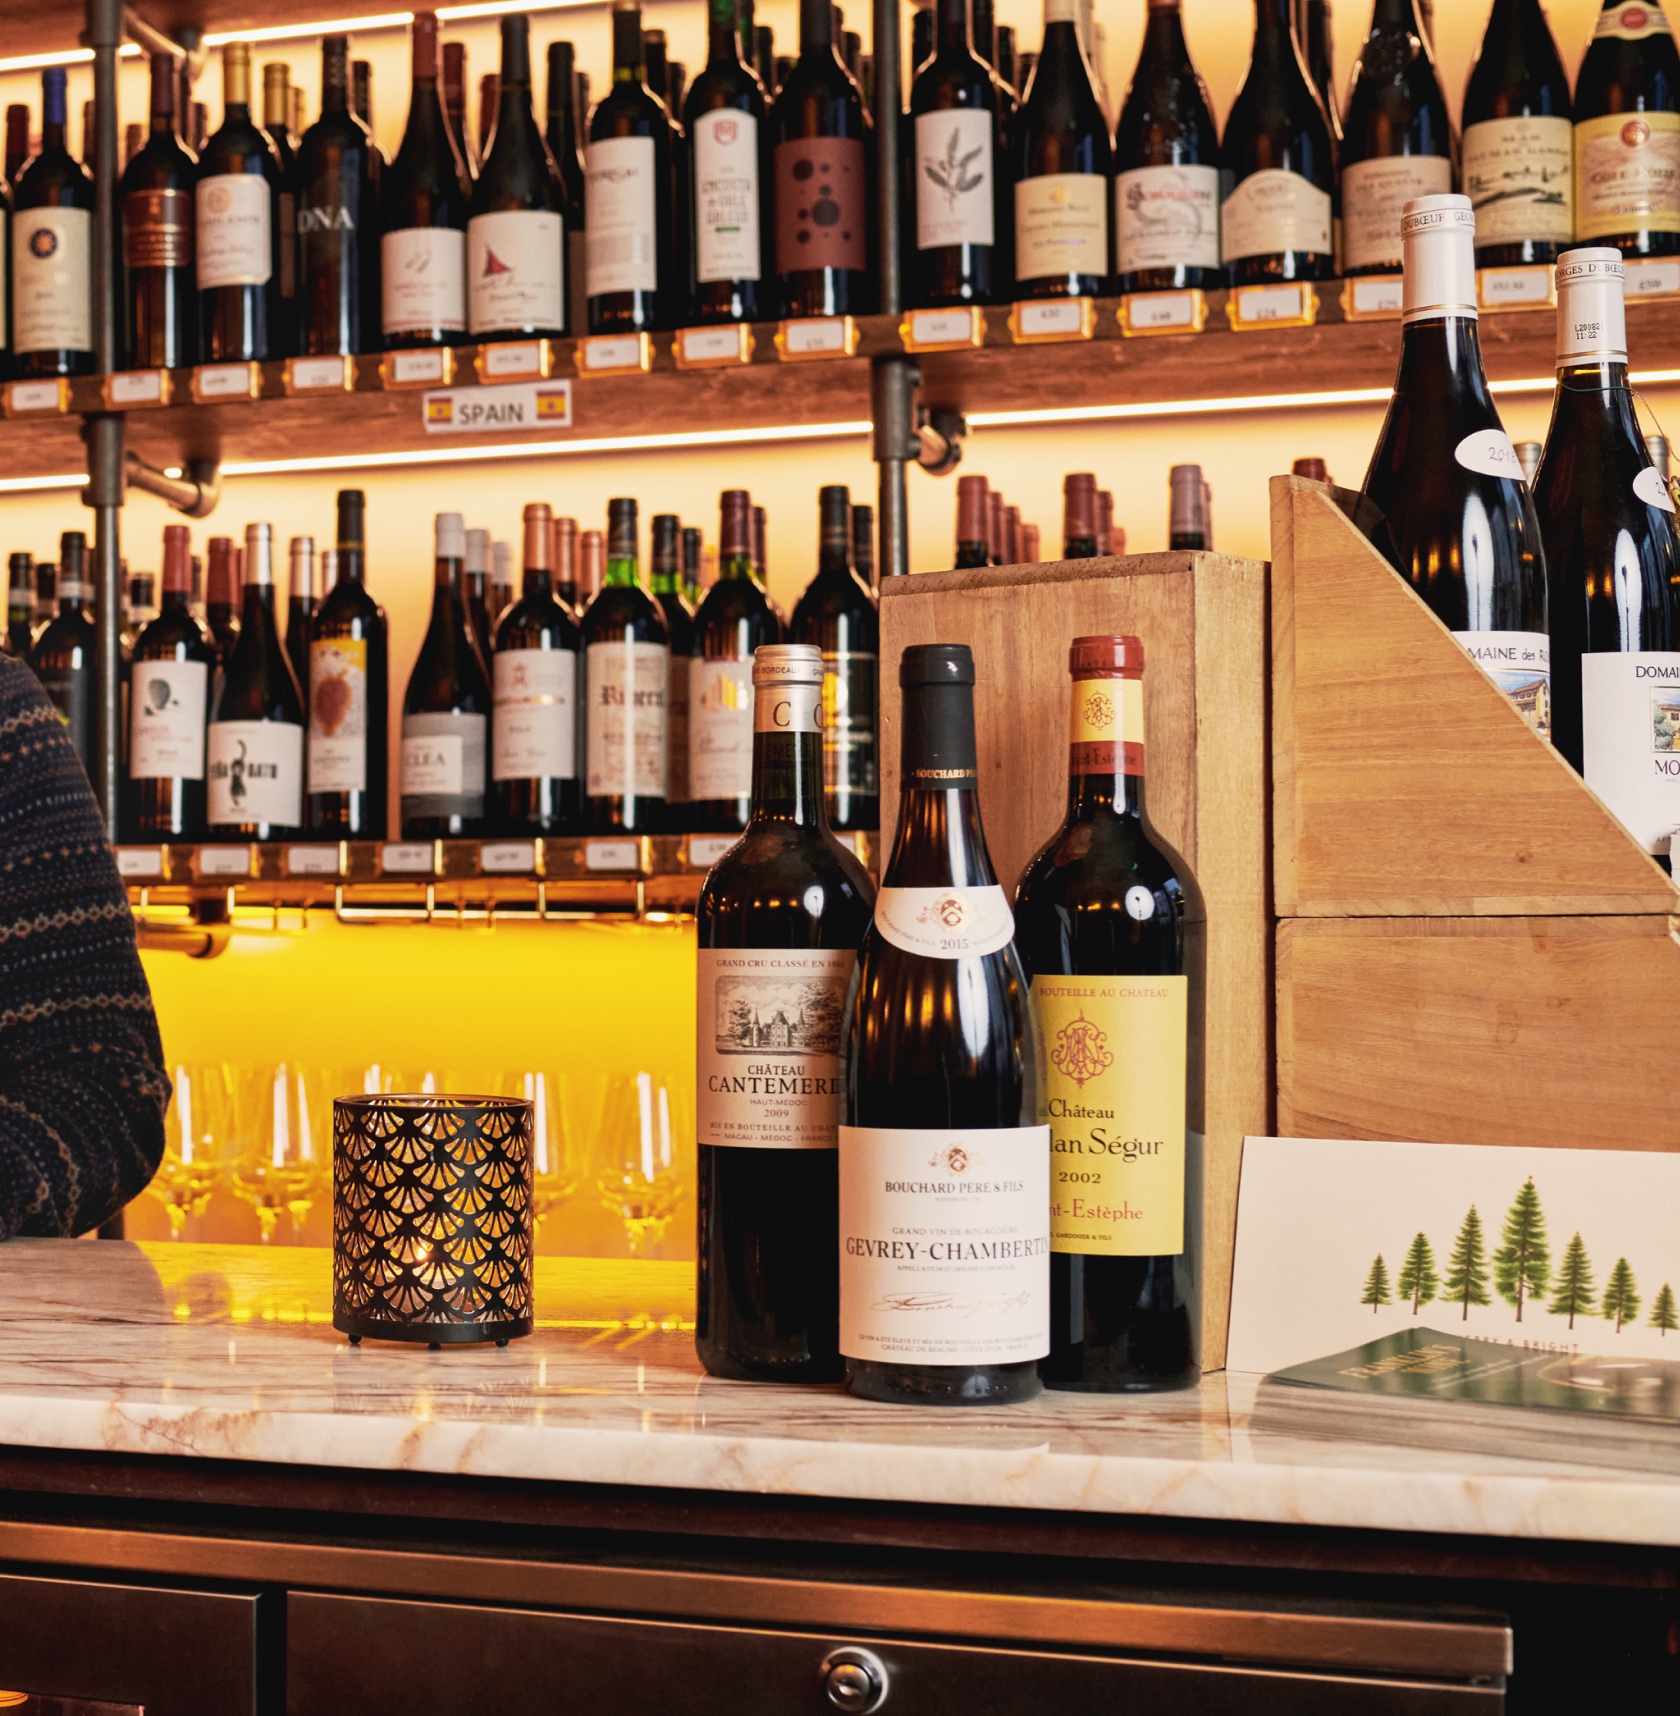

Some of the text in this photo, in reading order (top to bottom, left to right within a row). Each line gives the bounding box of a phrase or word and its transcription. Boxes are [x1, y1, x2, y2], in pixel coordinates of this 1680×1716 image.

[1403, 212, 1444, 230] DUBŒUF
[1555, 264, 1583, 280] ORGES
[1576, 331, 1598, 340] 11:22
[458, 403, 524, 425] SPAIN
[1469, 647, 1517, 661] MAINE
[1521, 649, 1535, 661] des
[762, 666, 801, 675] BORDEAUX
[1635, 665, 1680, 678] DOMAI
[915, 769, 965, 779] BOUCHARD
[1654, 759, 1680, 776] MO
[939, 938, 969, 950] 2015
[716, 959, 746, 968] GRAND
[747, 959, 768, 968] CRU
[770, 958, 809, 968] CLASSÉ
[811, 960, 825, 968] EN
[1039, 987, 1170, 998] BOUTEILLE AU CHATEAU
[747, 1063, 806, 1076] CHÂTEAU
[708, 1075, 842, 1095] CANTEMERL
[763, 1108, 790, 1118] 2009
[1048, 1098, 1115, 1119] Château
[723, 1122, 735, 1130] EN
[737, 1123, 791, 1132] BOUTEILLE
[794, 1124, 808, 1132] AU
[724, 1133, 753, 1141] MACAU
[800, 1134, 833, 1142] FRANCE
[1050, 1127, 1164, 1164] lan Ségur
[1058, 1171, 1102, 1184] 2002
[884, 1179, 1024, 1194] BOUCHARD PÈRE & FILS
[1050, 1198, 1144, 1223] nt-Estèphe
[891, 1226, 1019, 1236] GRAND VIN DE BOURGOGNE
[896, 1264, 944, 1272] APPELLATION
[881, 1343, 915, 1352] CHÂTEAU
[928, 1345, 959, 1353] BEAUNE
[1523, 1339, 1580, 1353] BRIGHT
